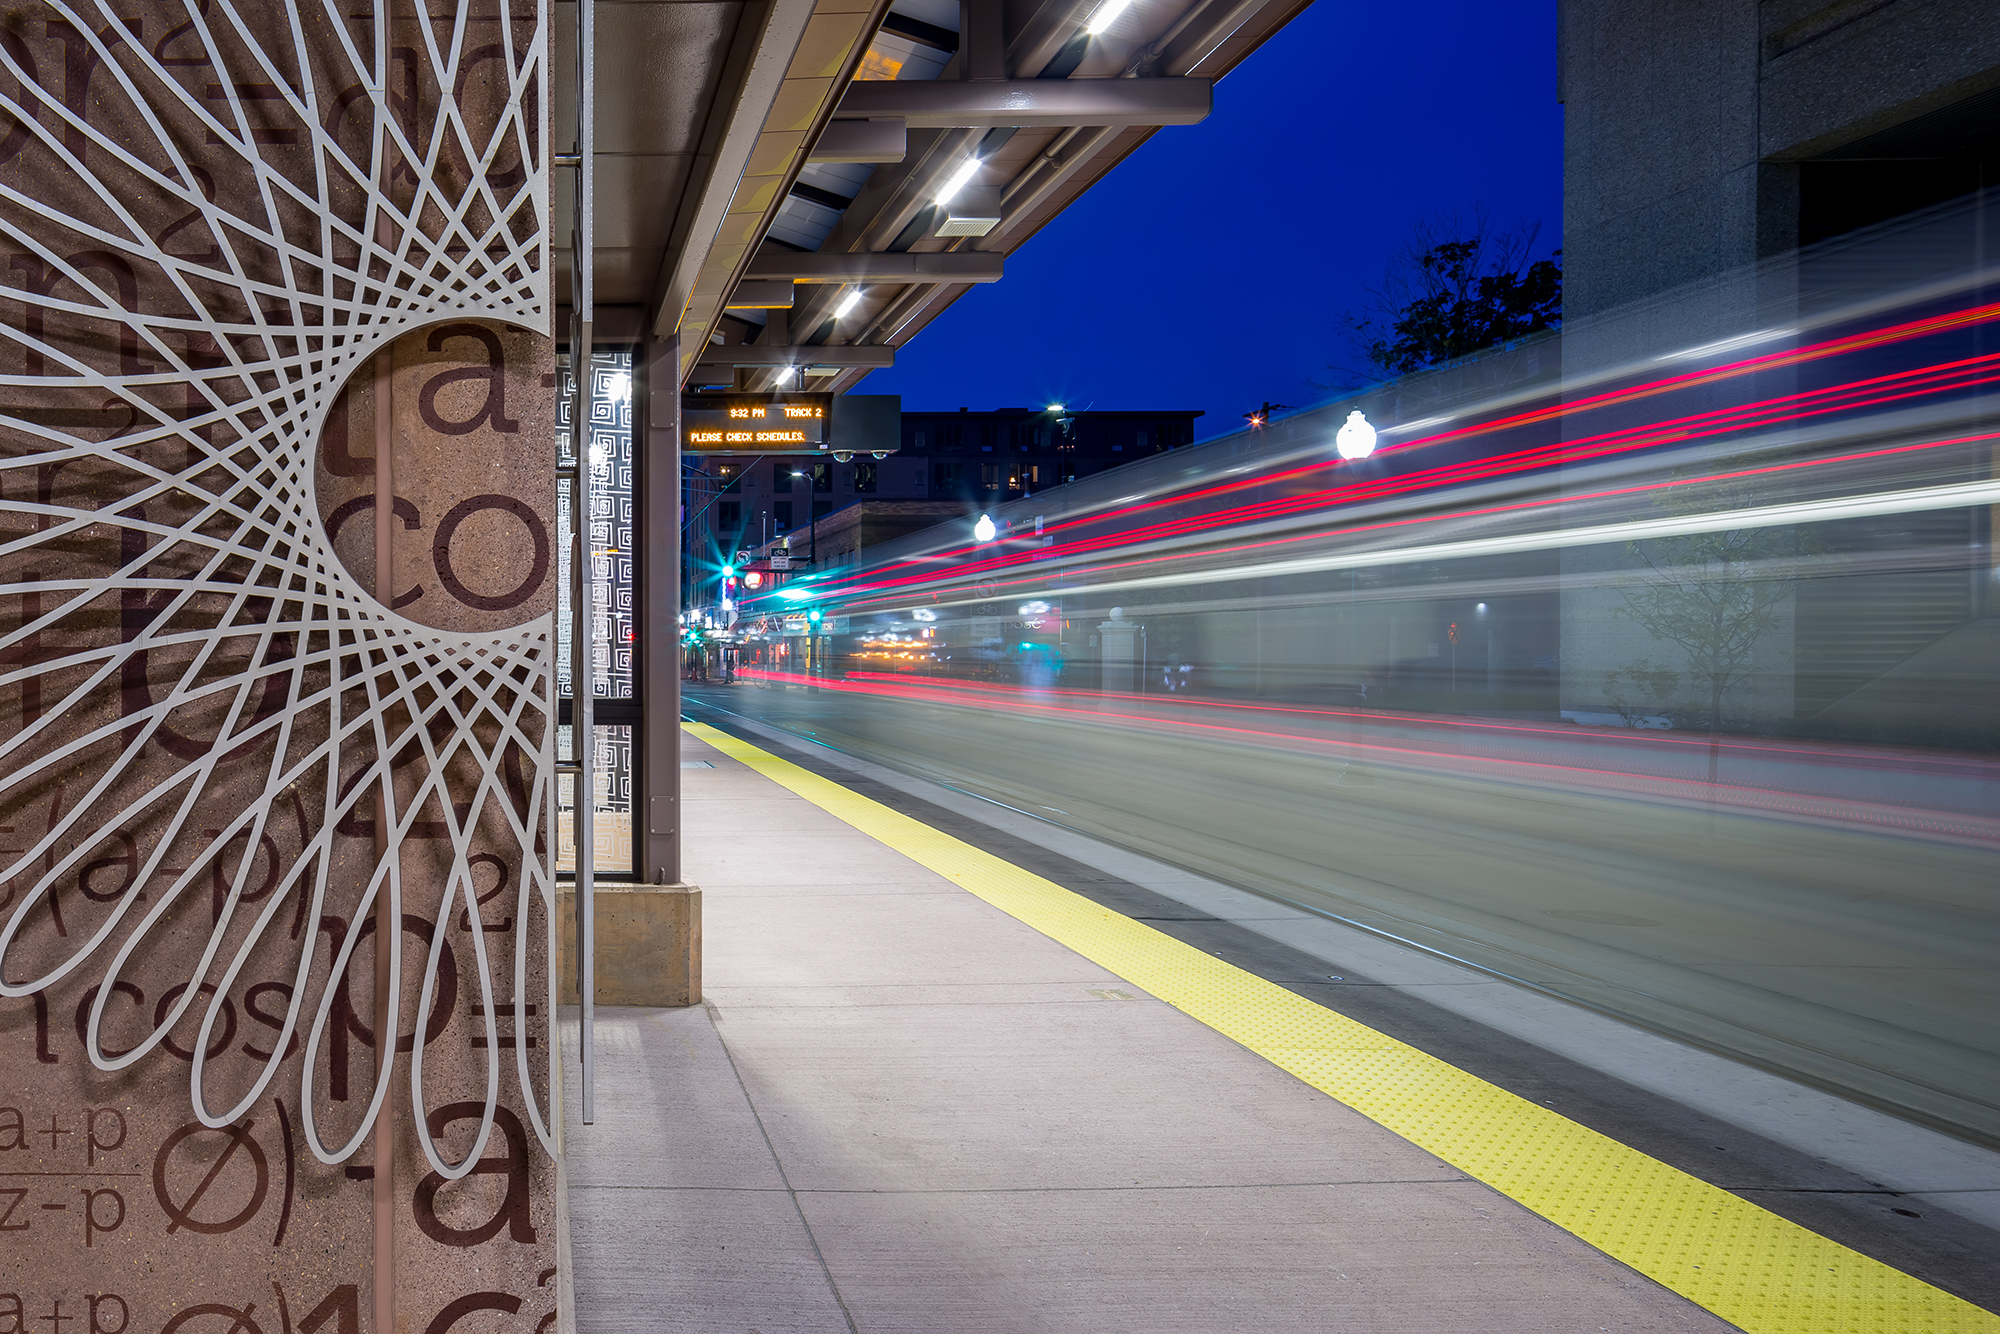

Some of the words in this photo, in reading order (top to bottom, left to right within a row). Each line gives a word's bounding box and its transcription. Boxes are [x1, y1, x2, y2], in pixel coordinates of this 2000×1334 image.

[730, 408, 749, 418] 9:32
[752, 408, 765, 418] PM
[784, 407, 813, 418] TRACK
[816, 408, 822, 417] 2
[691, 432, 723, 442] PLEASE
[726, 432, 753, 442] CHECK
[756, 431, 805, 442] SCHEDULES.
